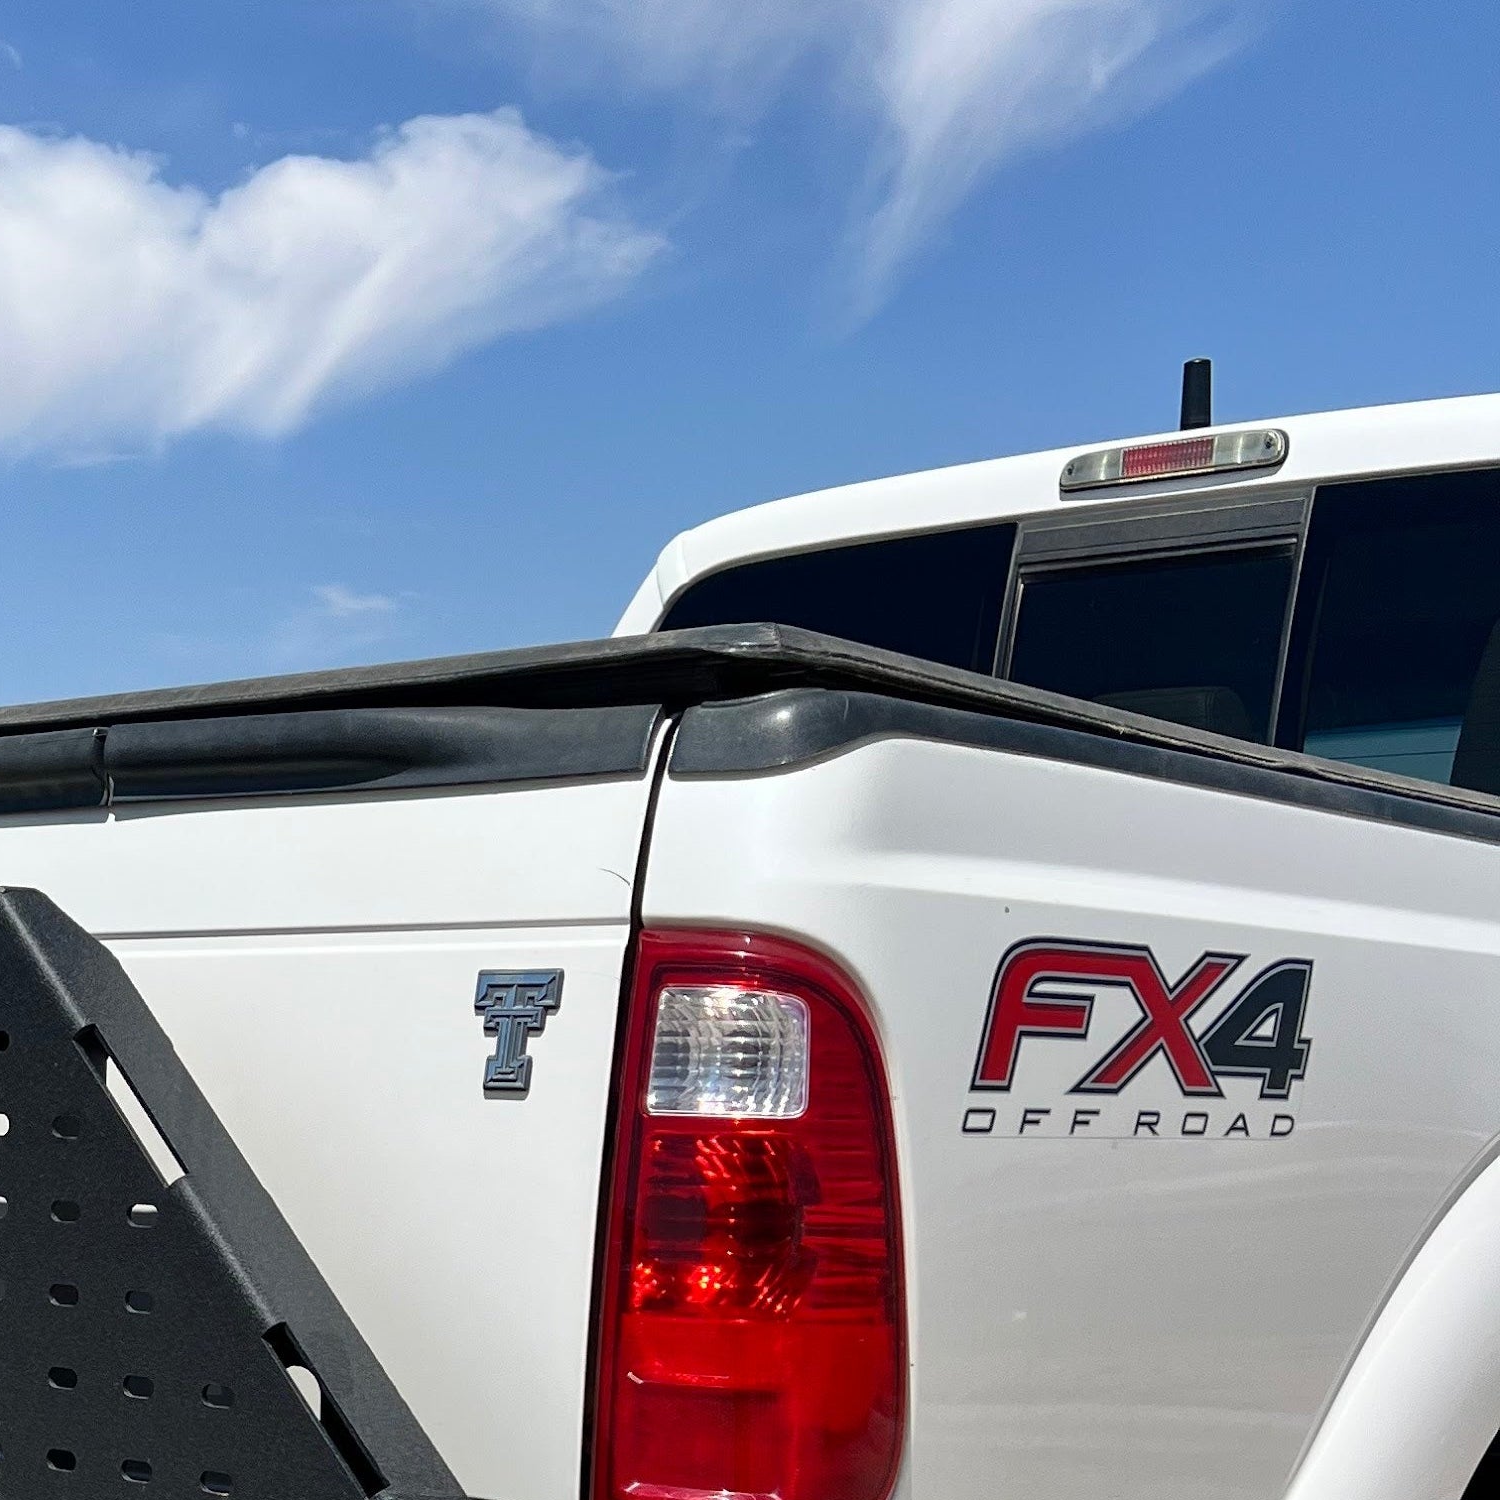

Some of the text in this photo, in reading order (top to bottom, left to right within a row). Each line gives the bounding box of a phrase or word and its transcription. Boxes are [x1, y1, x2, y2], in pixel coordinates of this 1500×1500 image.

[968, 934, 1315, 1101] FX4
[961, 1107, 1296, 1138] OFF ROAD
